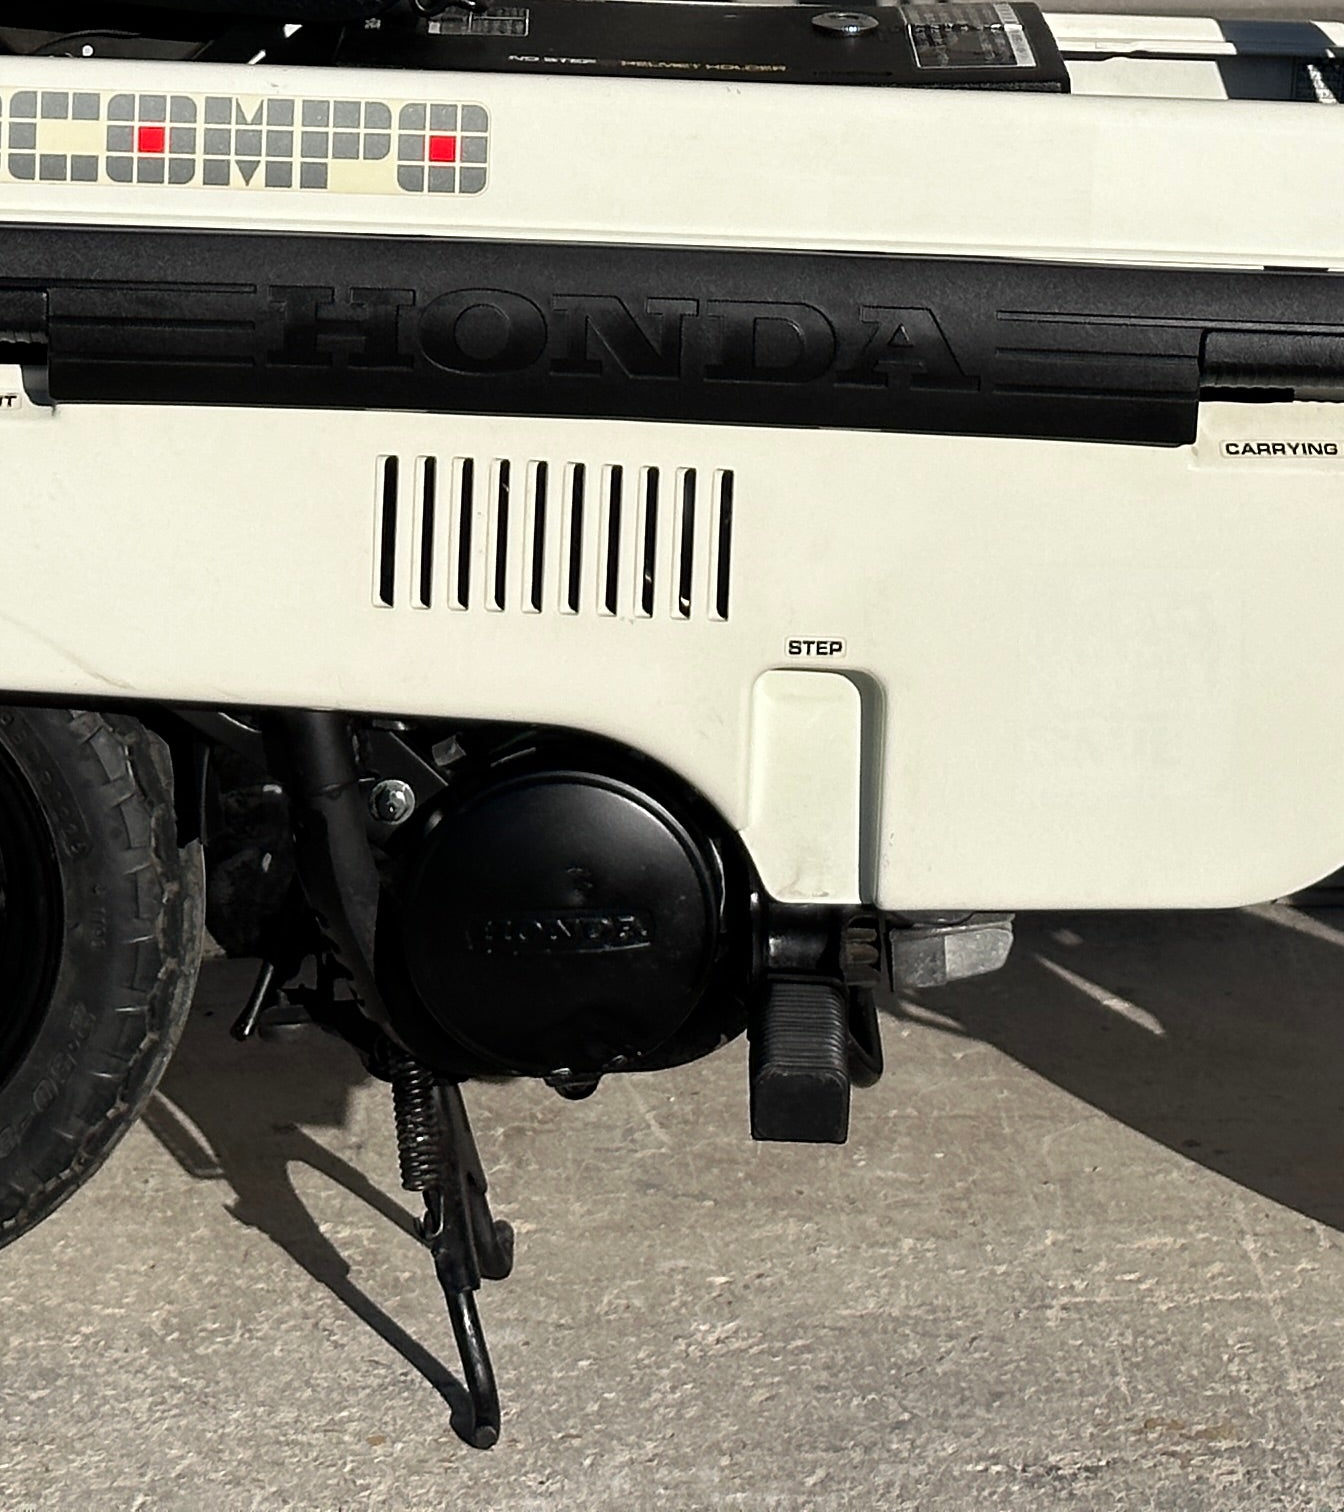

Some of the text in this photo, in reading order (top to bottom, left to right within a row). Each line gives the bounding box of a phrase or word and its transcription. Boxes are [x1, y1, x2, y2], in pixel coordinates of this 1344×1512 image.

[543, 56, 597, 65] STEP
[620, 60, 787, 73] HELMET HOLDER
[266, 285, 981, 391] HONDA
[1225, 442, 1338, 456] CARRYING
[788, 640, 843, 656] STEP
